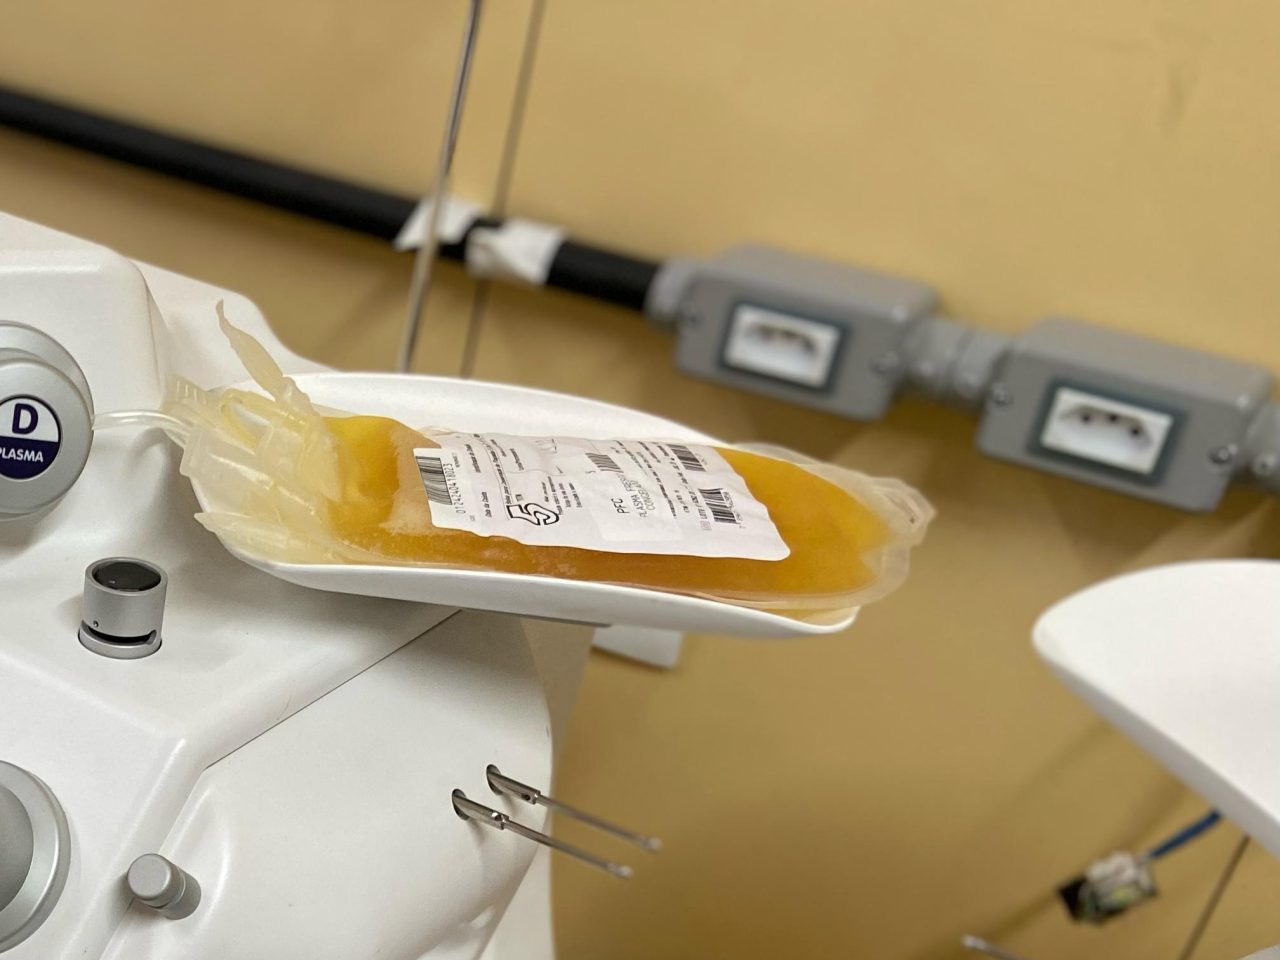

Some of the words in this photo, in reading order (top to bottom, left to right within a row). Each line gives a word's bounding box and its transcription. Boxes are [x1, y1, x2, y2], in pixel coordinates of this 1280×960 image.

[11, 403, 39, 435] D
[506, 503, 559, 526] 5
[611, 497, 630, 514] PFC
[631, 494, 648, 518] PLASMA
